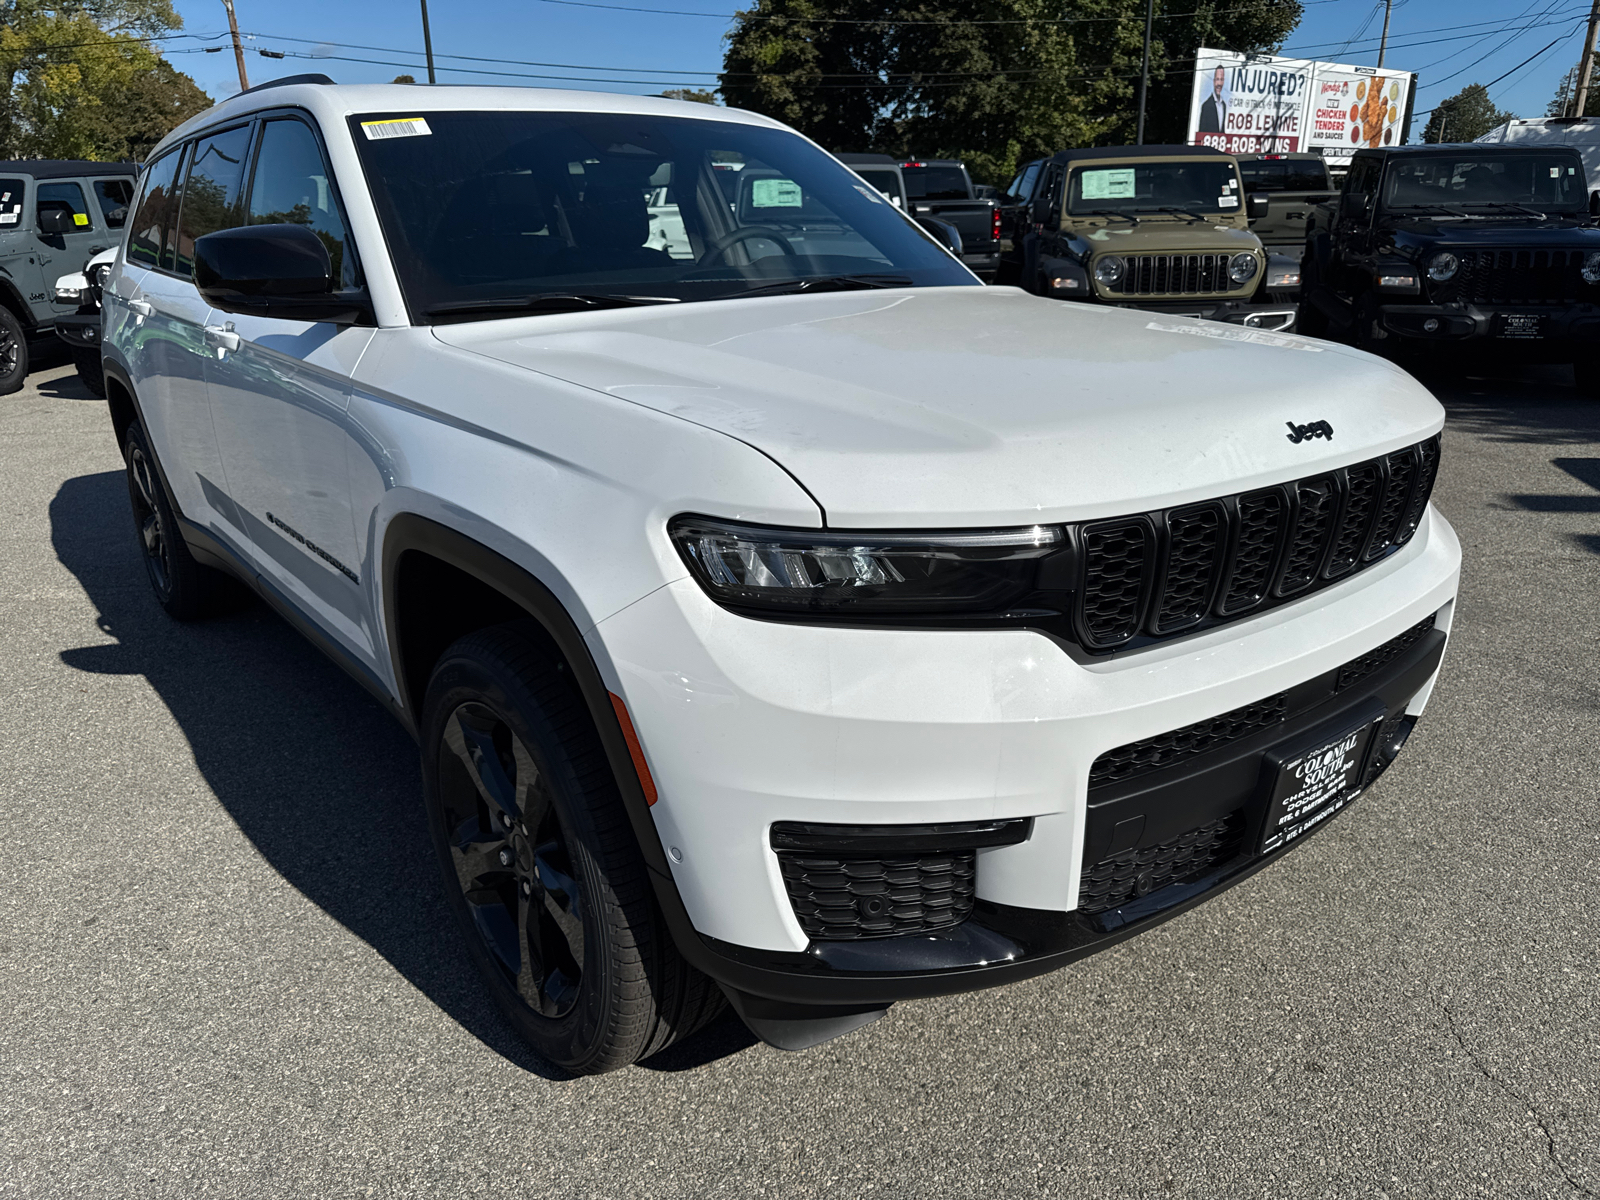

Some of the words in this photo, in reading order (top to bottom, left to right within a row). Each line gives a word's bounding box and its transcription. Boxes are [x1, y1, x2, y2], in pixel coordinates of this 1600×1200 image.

[1230, 67, 1305, 97] INJURED?
[1227, 113, 1253, 130] ROB
[1256, 115, 1298, 132] LEVINE
[1315, 120, 1345, 131] TENDERS
[1316, 108, 1347, 120] CHICKEN
[1325, 132, 1343, 140] SAUCES
[1285, 419, 1334, 445] Jeep
[1295, 734, 1358, 779] COLONIAL
[1302, 754, 1346, 789] SOUTH
[1282, 773, 1336, 805] CHRYSLER
[1287, 789, 1323, 811] DODGE
